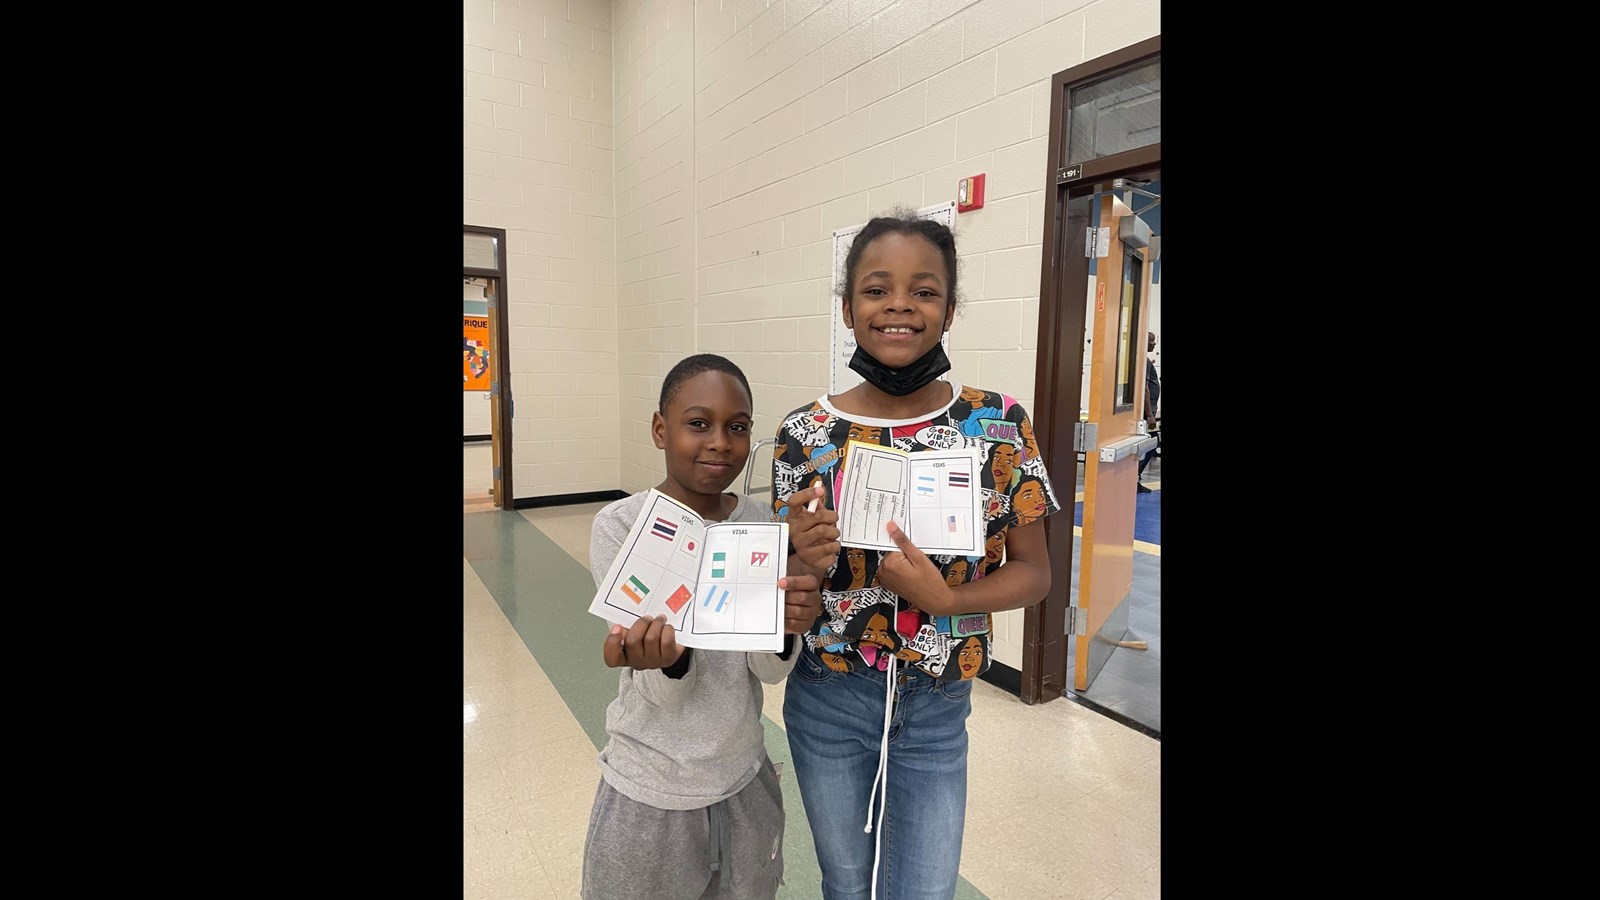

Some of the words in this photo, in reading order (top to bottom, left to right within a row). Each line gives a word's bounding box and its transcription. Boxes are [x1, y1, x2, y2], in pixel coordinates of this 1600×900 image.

[464, 319, 488, 328] RIQUE
[928, 426, 958, 437] GOOD
[926, 432, 957, 444] VIBES
[927, 439, 955, 450] ONLY
[681, 515, 694, 525] VISAS
[915, 635, 936, 645] IBES
[910, 640, 934, 653] ONLY
